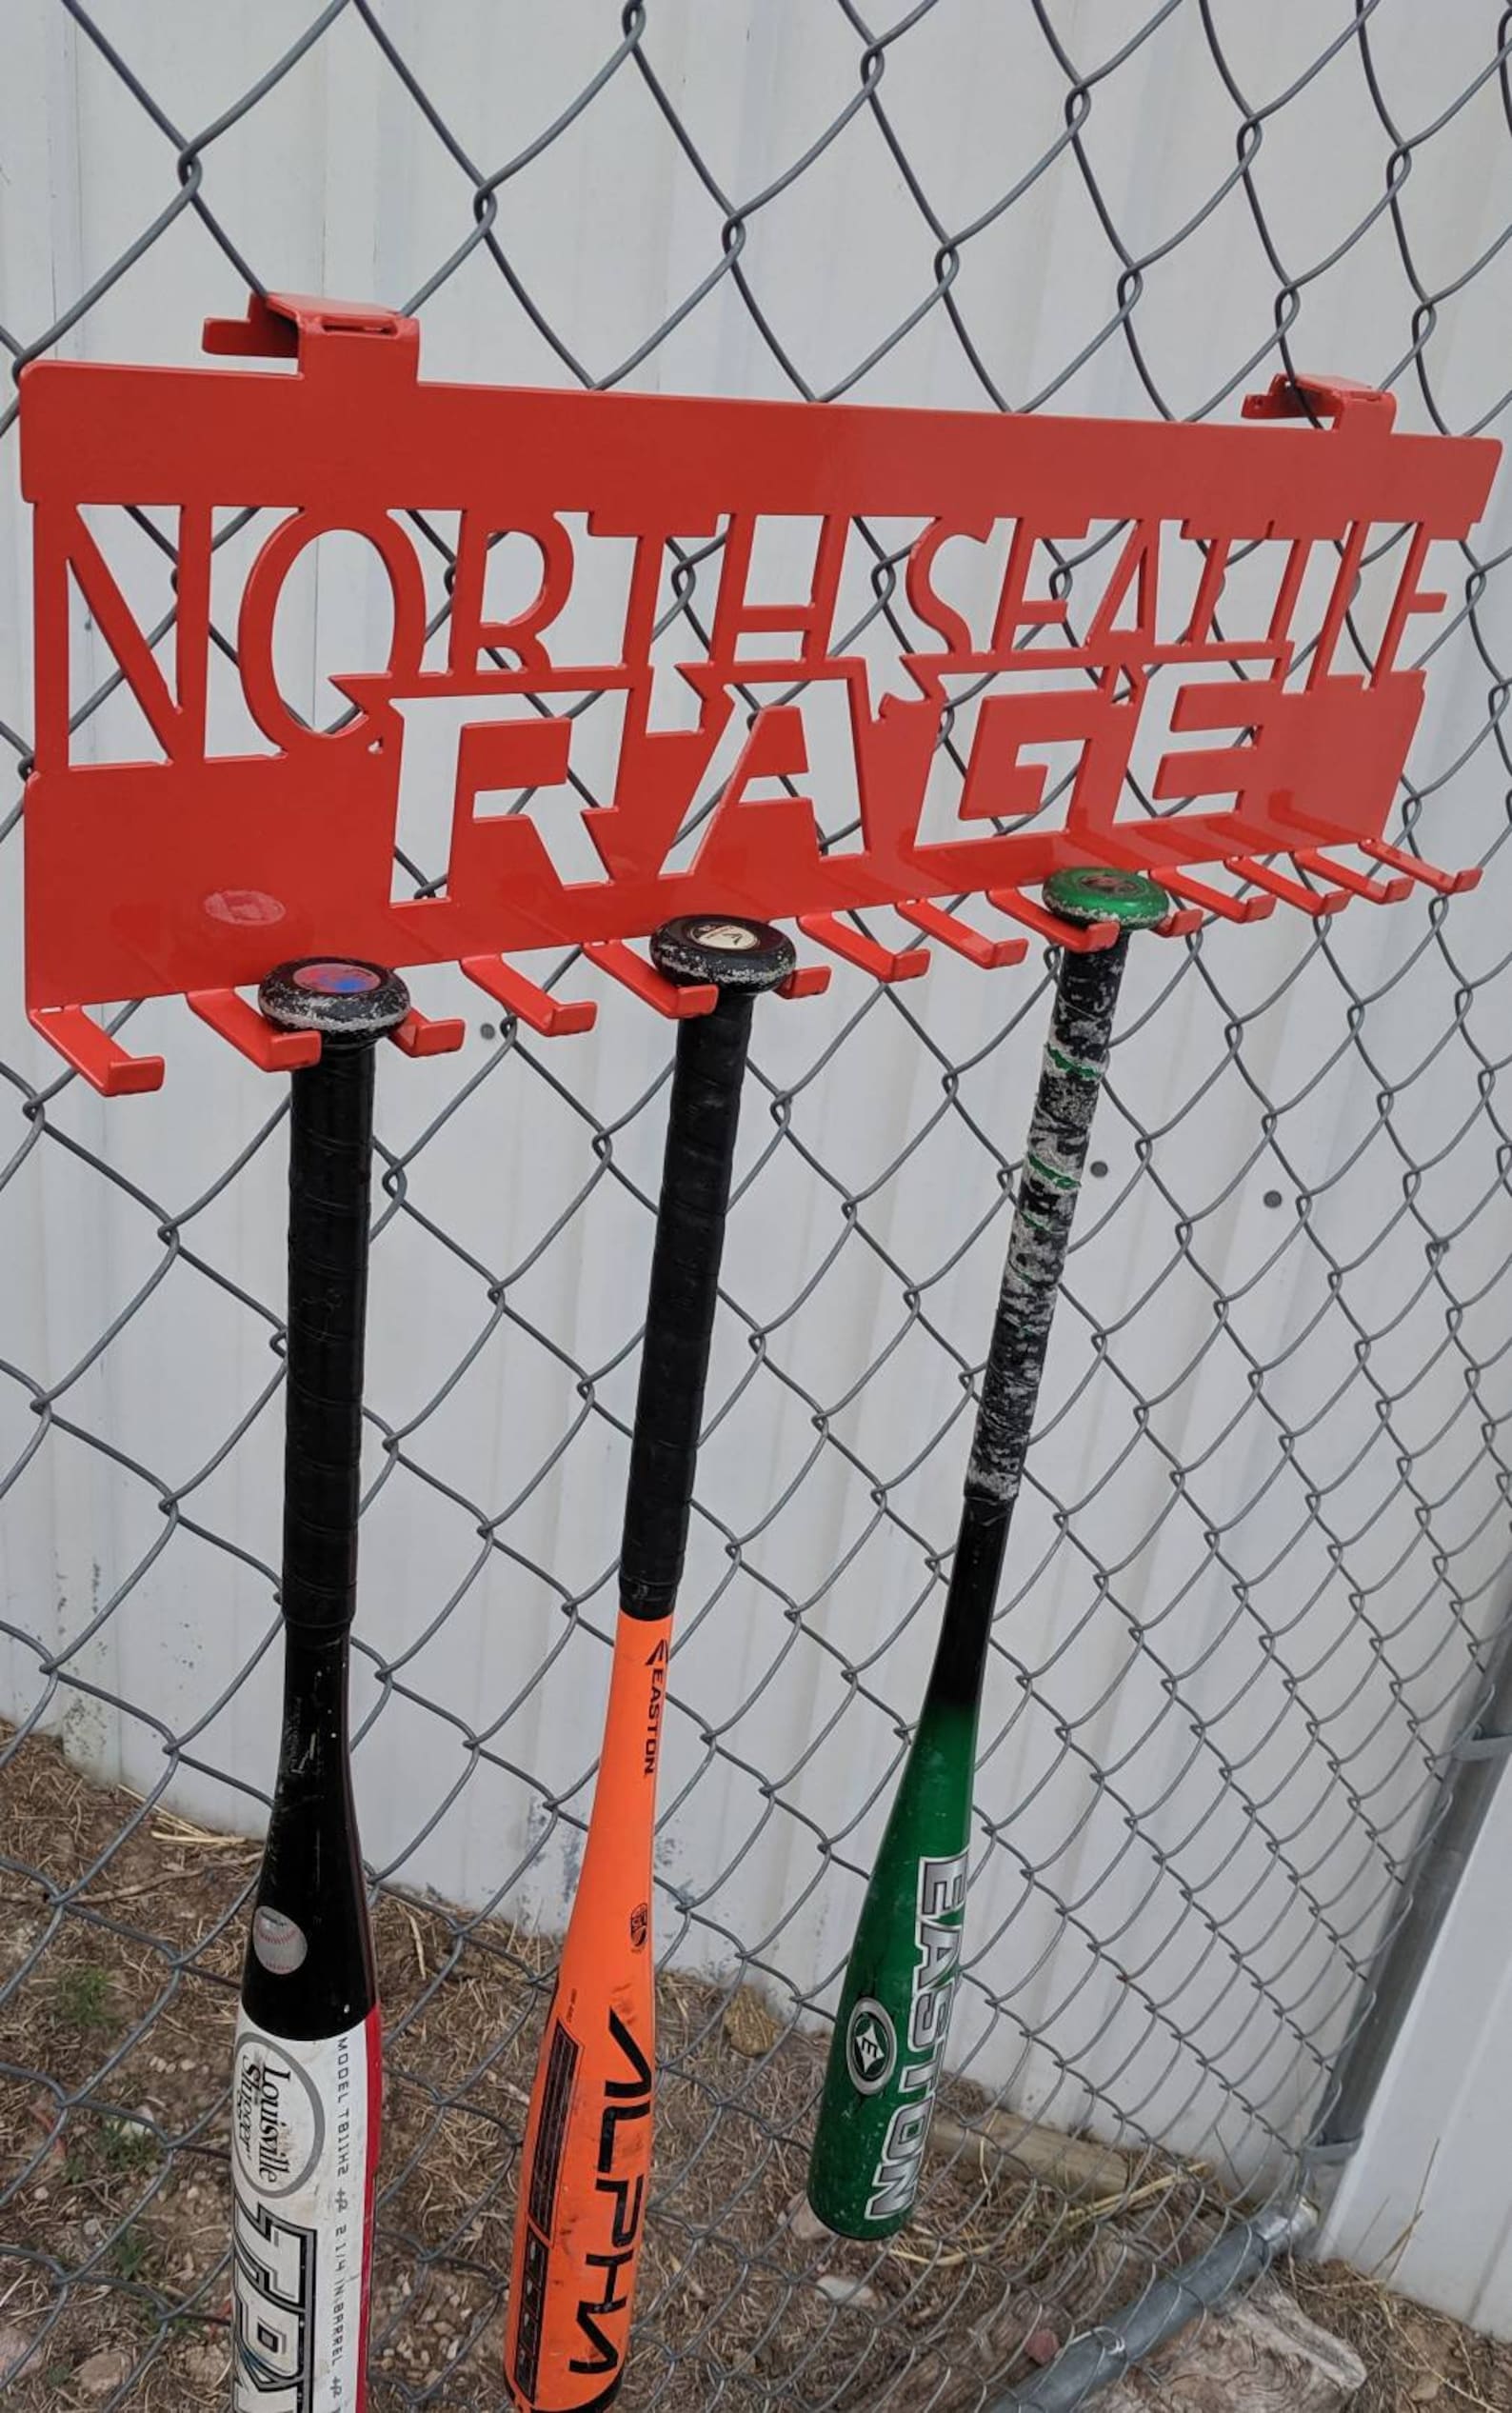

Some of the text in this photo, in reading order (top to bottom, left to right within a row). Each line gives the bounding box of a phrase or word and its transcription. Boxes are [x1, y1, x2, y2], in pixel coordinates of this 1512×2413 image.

[32, 503, 850, 769] NORTH
[388, 657, 1283, 907] RAGE
[644, 1667, 665, 1777] EASTON
[258, 2062, 291, 2184] Louisville
[337, 2036, 349, 2104] MODEL
[864, 1849, 969, 2221] EASTON
[568, 2005, 652, 2375] ALPHA
